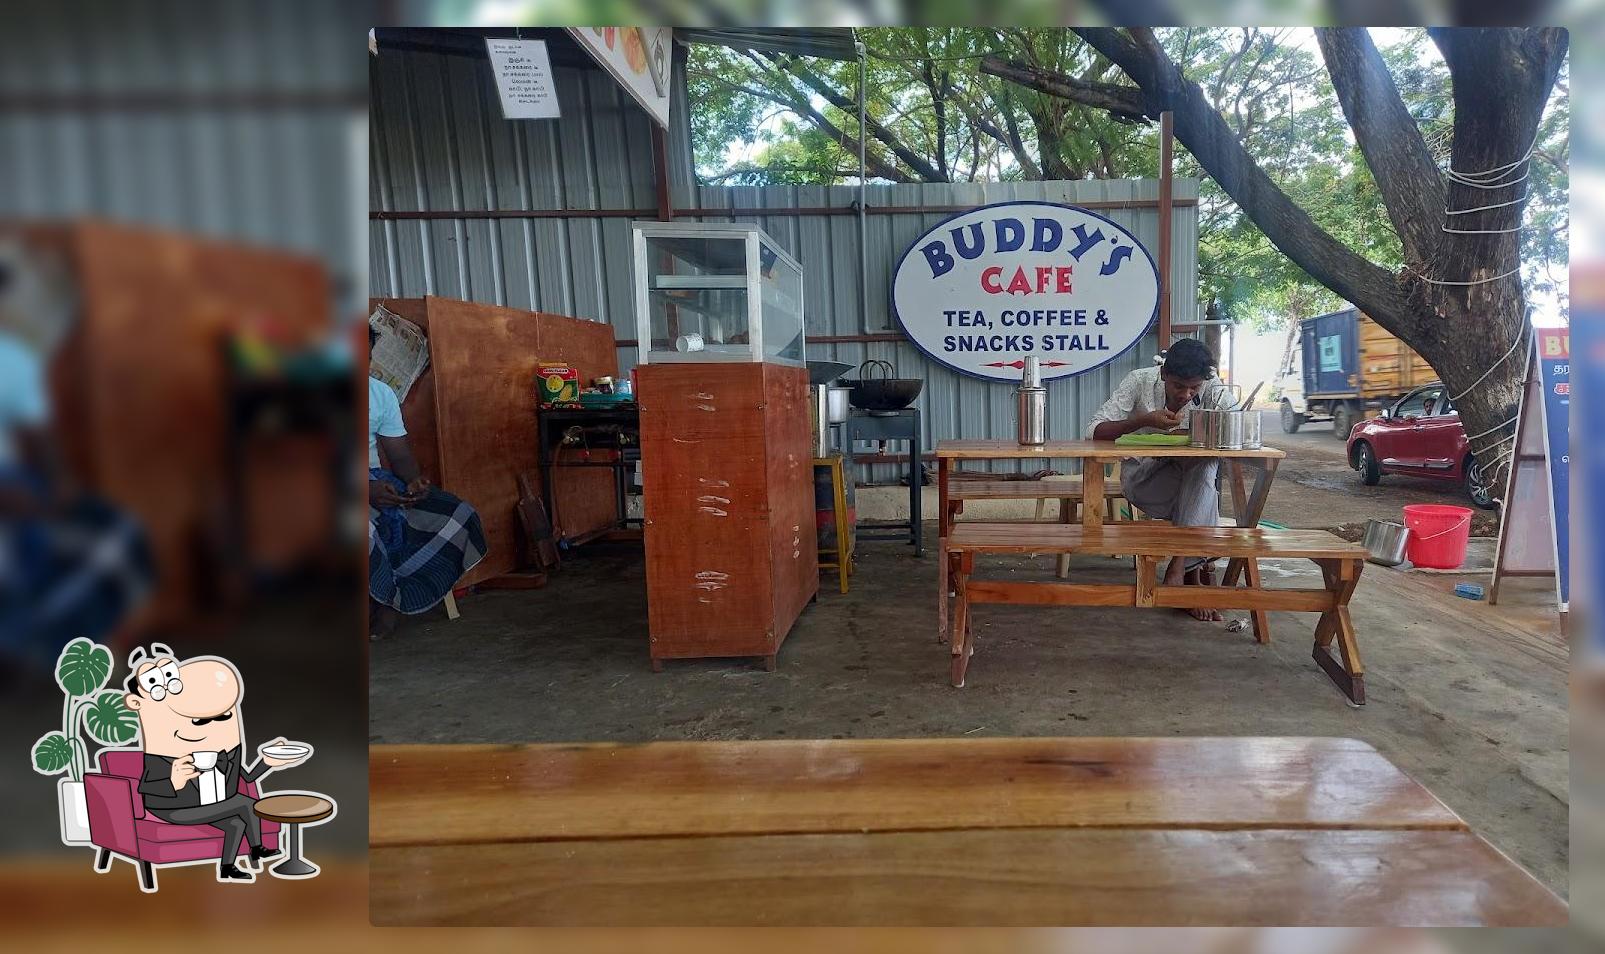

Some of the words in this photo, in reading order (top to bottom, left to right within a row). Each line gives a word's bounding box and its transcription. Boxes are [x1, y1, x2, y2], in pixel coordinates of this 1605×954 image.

[981, 265, 1073, 296] CAFE
[943, 310, 993, 330] TEA,
[1001, 310, 1087, 327] COFFEE
[1094, 309, 1109, 326] &
[943, 335, 1034, 352] SNACKS
[1041, 334, 1110, 351] STALL
